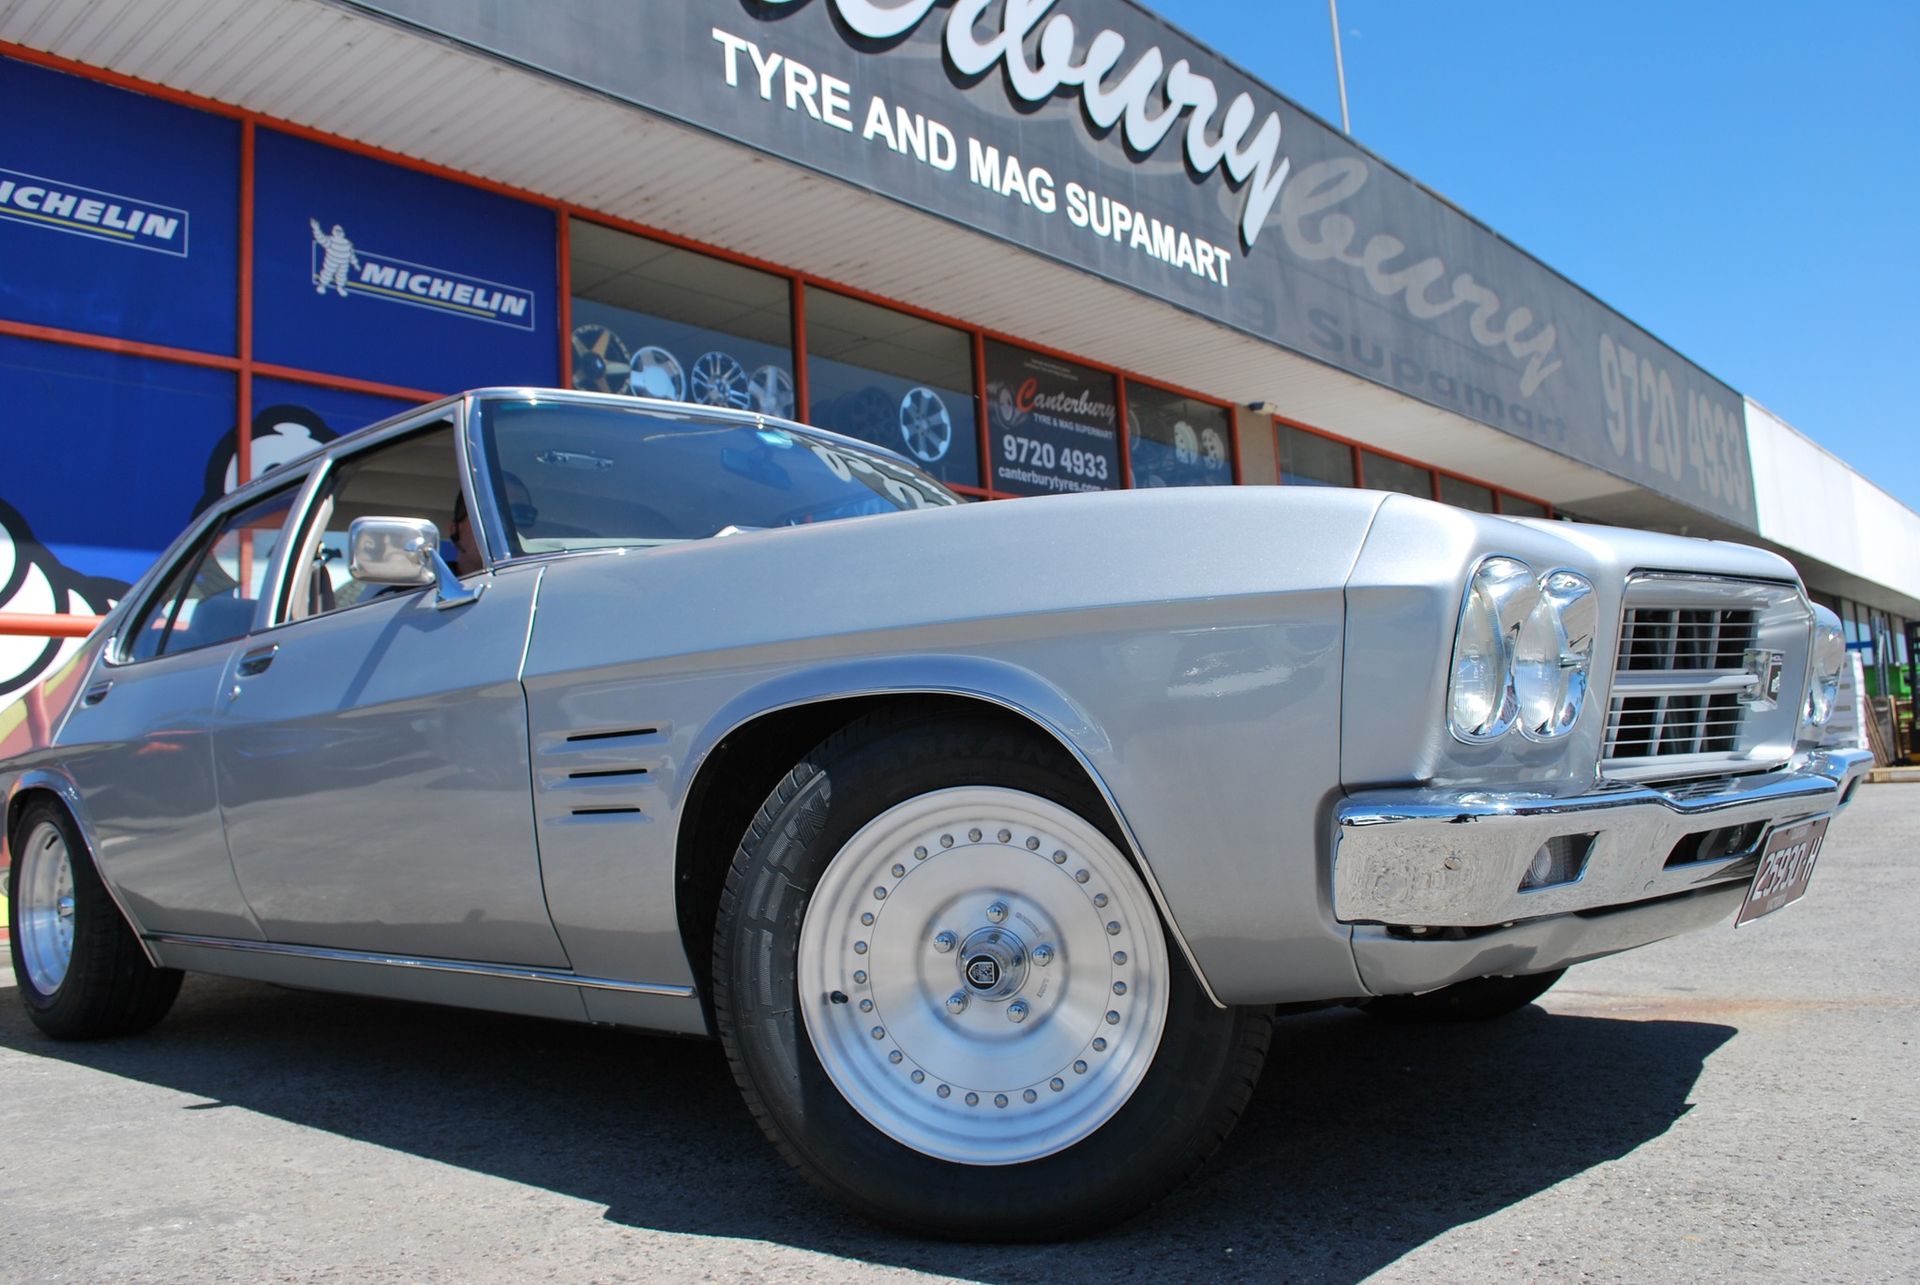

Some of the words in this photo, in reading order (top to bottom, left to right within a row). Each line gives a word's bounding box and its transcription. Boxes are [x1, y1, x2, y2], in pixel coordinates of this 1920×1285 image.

[711, 28, 853, 133] TYRE
[863, 96, 957, 172] AND
[968, 137, 1056, 213] MAG
[1066, 183, 1231, 287] SUPAMART
[0, 181, 178, 239] ICHELIN
[361, 262, 527, 316] MICHELIN
[1016, 377, 1116, 424] Canterbury
[1033, 412, 1052, 426] TYRE
[1599, 333, 1682, 481] 9720
[1688, 389, 1748, 513] 4933
[1003, 434, 1055, 469] 9720
[1060, 447, 1108, 481] 4933
